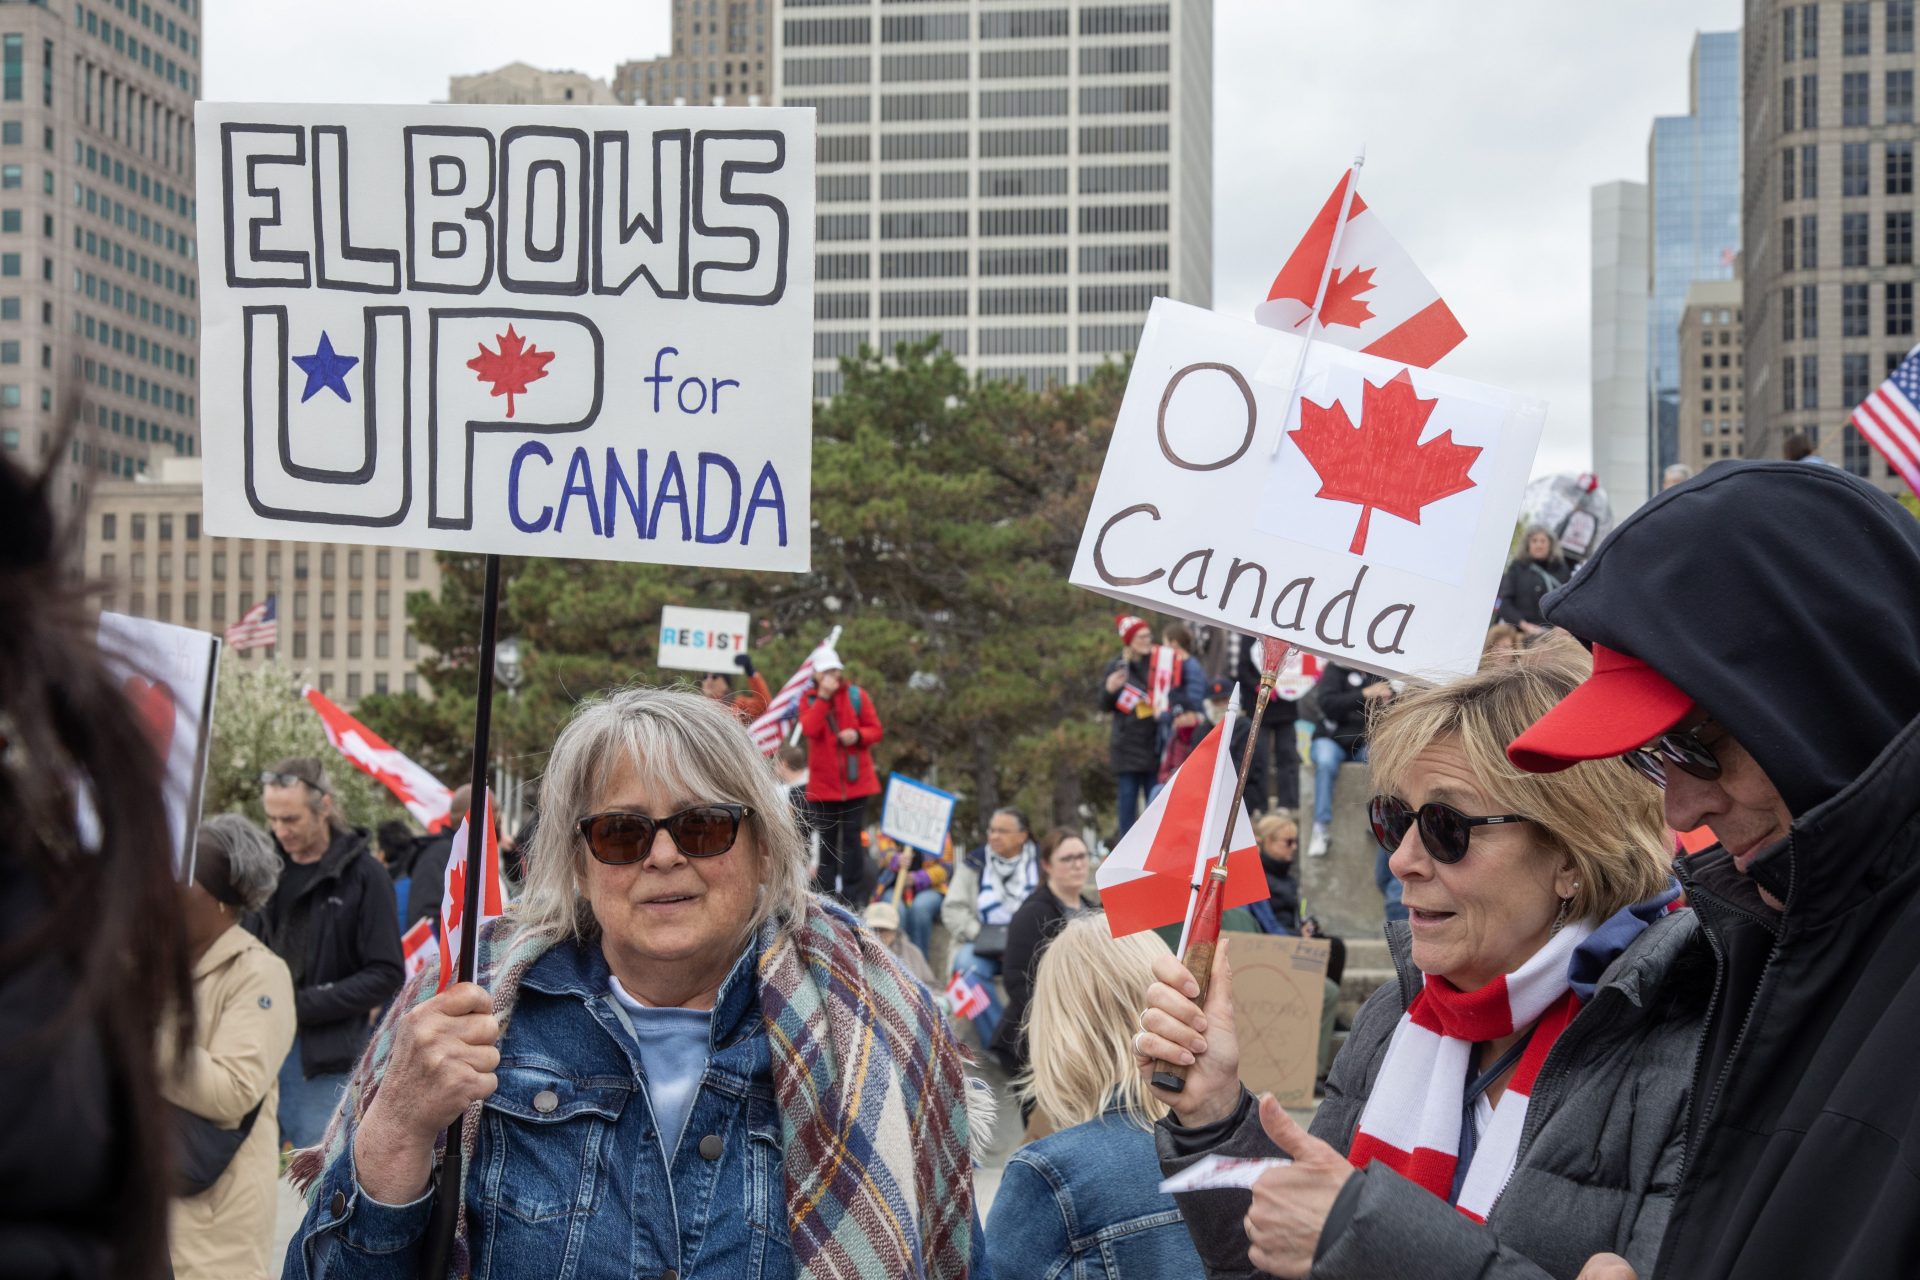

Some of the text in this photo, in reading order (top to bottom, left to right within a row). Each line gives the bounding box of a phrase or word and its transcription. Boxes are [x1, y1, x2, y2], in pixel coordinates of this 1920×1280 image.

[220, 122, 790, 306] ELBOWS
[242, 305, 741, 530] UP for
[1156, 361, 1258, 472] O
[507, 440, 788, 547] CANADA
[662, 627, 744, 652] RESIST
[1092, 502, 1416, 655] Canada
